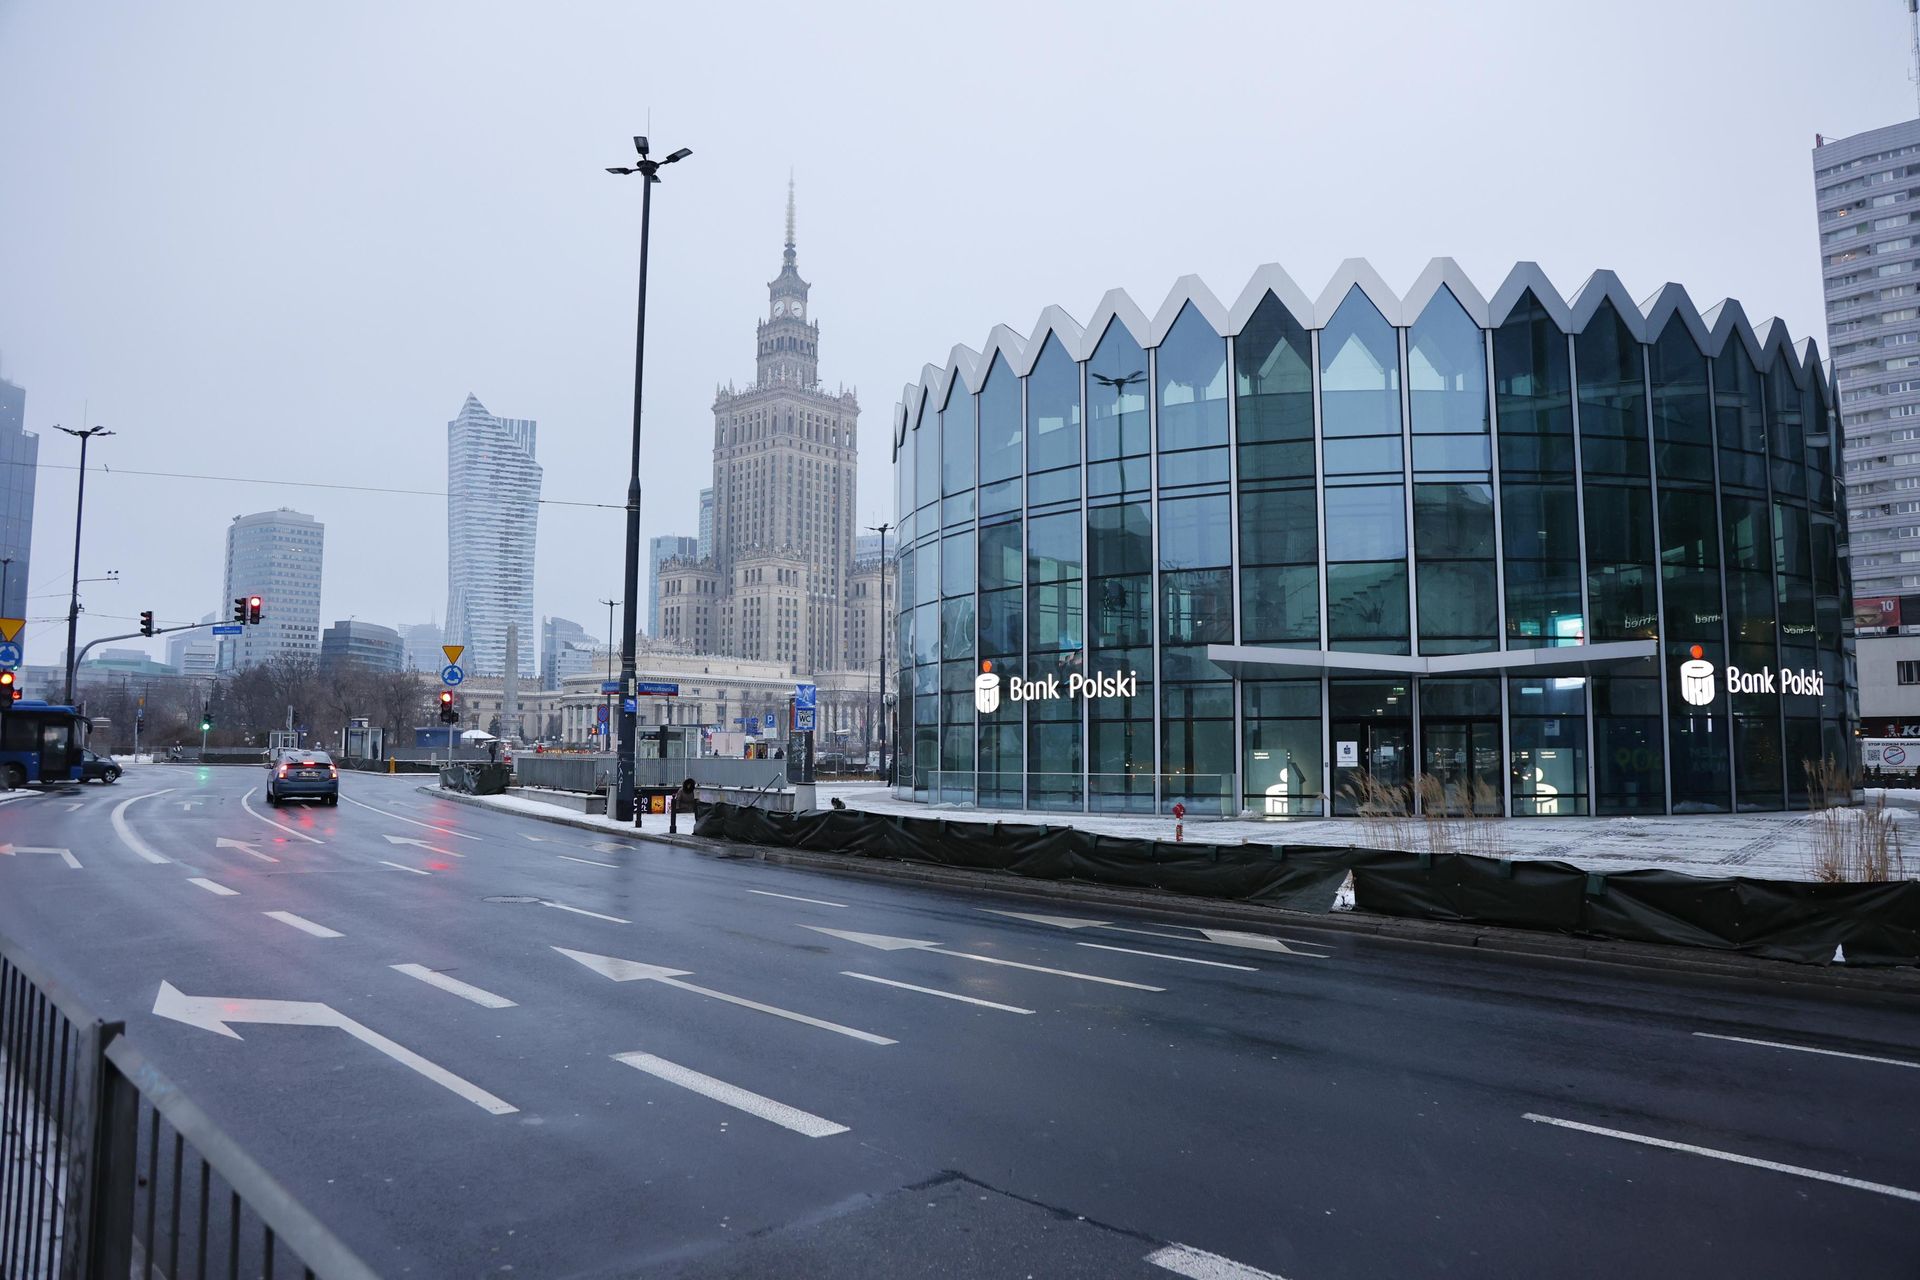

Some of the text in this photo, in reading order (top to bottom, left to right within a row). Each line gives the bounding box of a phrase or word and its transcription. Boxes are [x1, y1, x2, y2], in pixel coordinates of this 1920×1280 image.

[1010, 673, 1060, 701] Bank
[1069, 670, 1137, 699] Polski
[1727, 665, 1776, 694] Bank
[1781, 668, 1824, 696] Polski
[767, 715, 773, 724] P
[799, 715, 811, 723] WC
[1901, 725, 1920, 736] K
